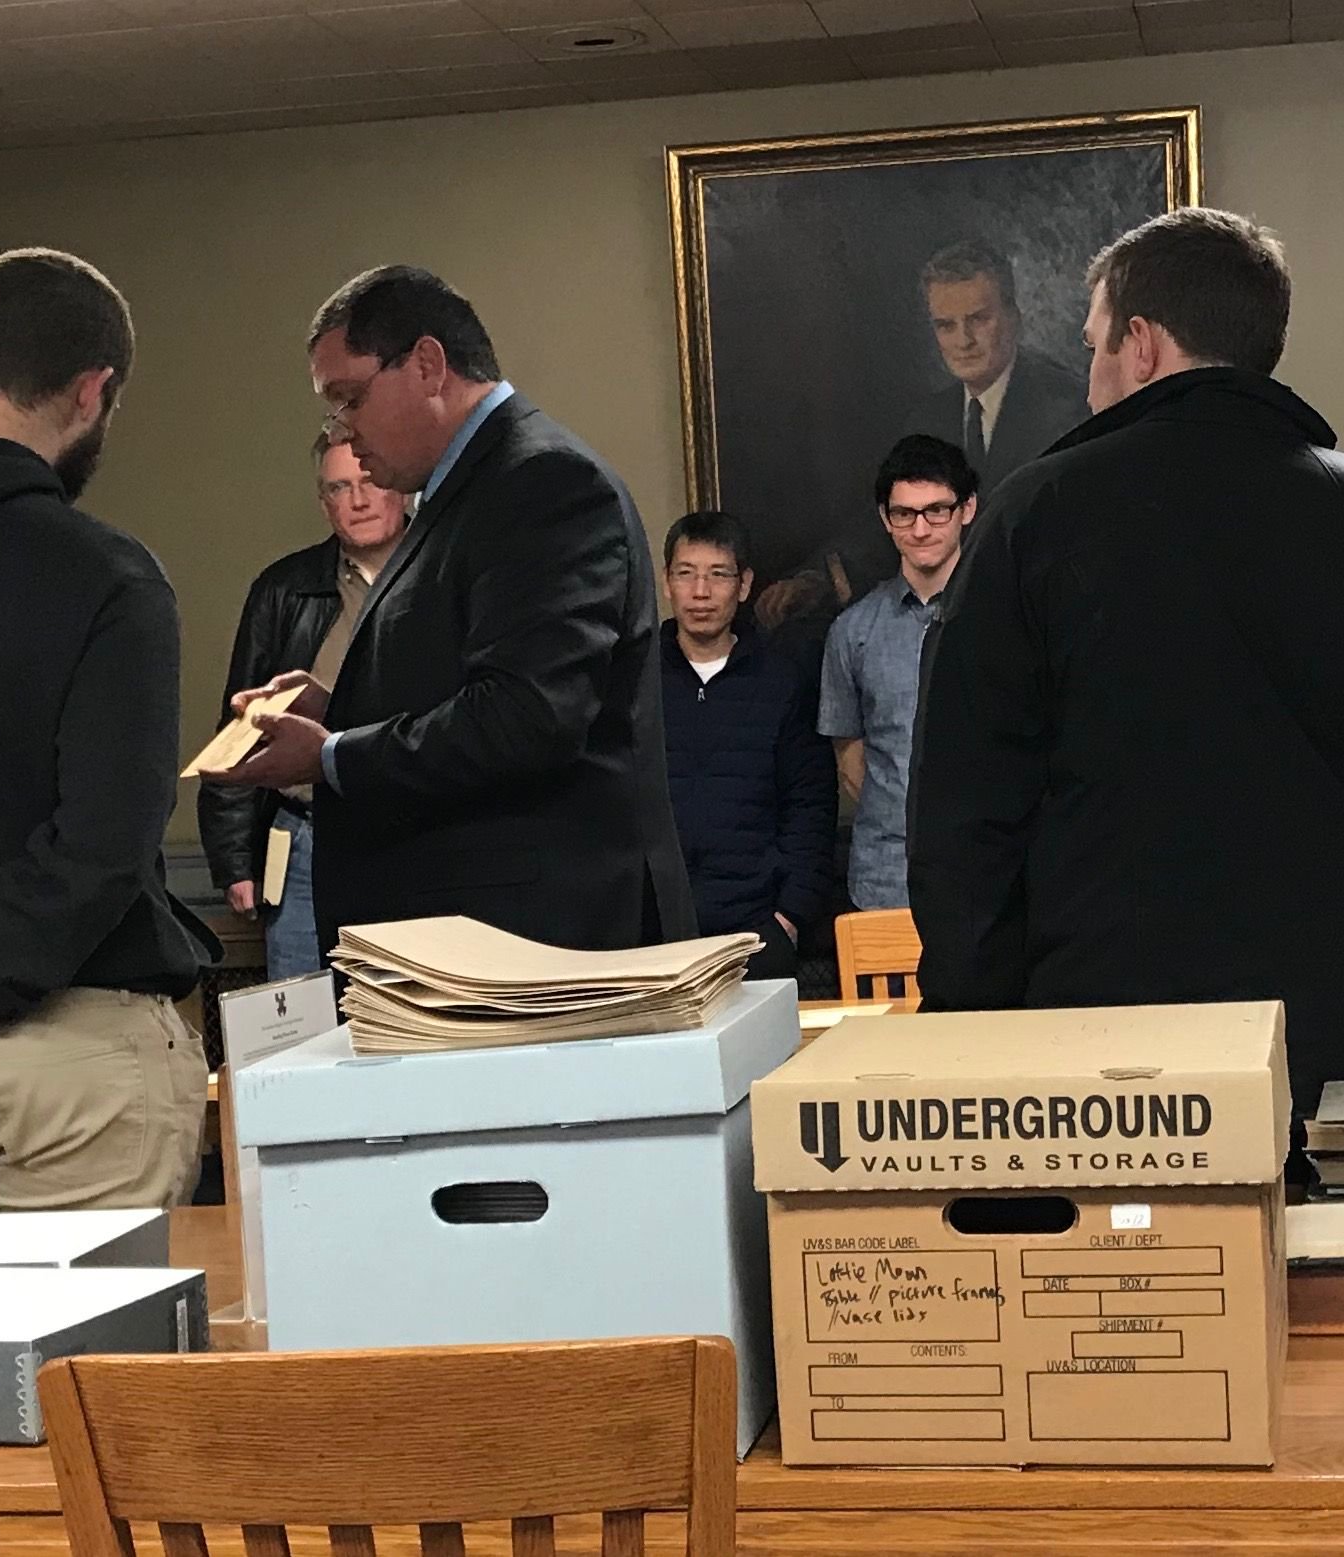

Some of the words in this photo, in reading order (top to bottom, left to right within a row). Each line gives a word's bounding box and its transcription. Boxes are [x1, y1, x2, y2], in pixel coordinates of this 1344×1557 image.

[857, 1094, 1212, 1142] UNDERGROUND
[861, 1154, 988, 1173] VAULTS
[1007, 1154, 1025, 1171] &
[1045, 1152, 1209, 1171] STORAGE
[803, 1238, 832, 1250] UV&S
[835, 1238, 856, 1249] BAR
[859, 1237, 886, 1249] CODE
[889, 1237, 920, 1249] LABEL
[1089, 1235, 1126, 1247] CLIENT
[1043, 1278, 1069, 1290] DATE
[1119, 1278, 1142, 1290] BOX
[888, 1285, 946, 1307] picture
[1099, 1319, 1154, 1331] SHIPMENT
[828, 1352, 858, 1364] FROM
[1046, 1360, 1078, 1372] UV&S
[1083, 1360, 1136, 1372] LOCATION
[831, 1397, 844, 1409] TO
